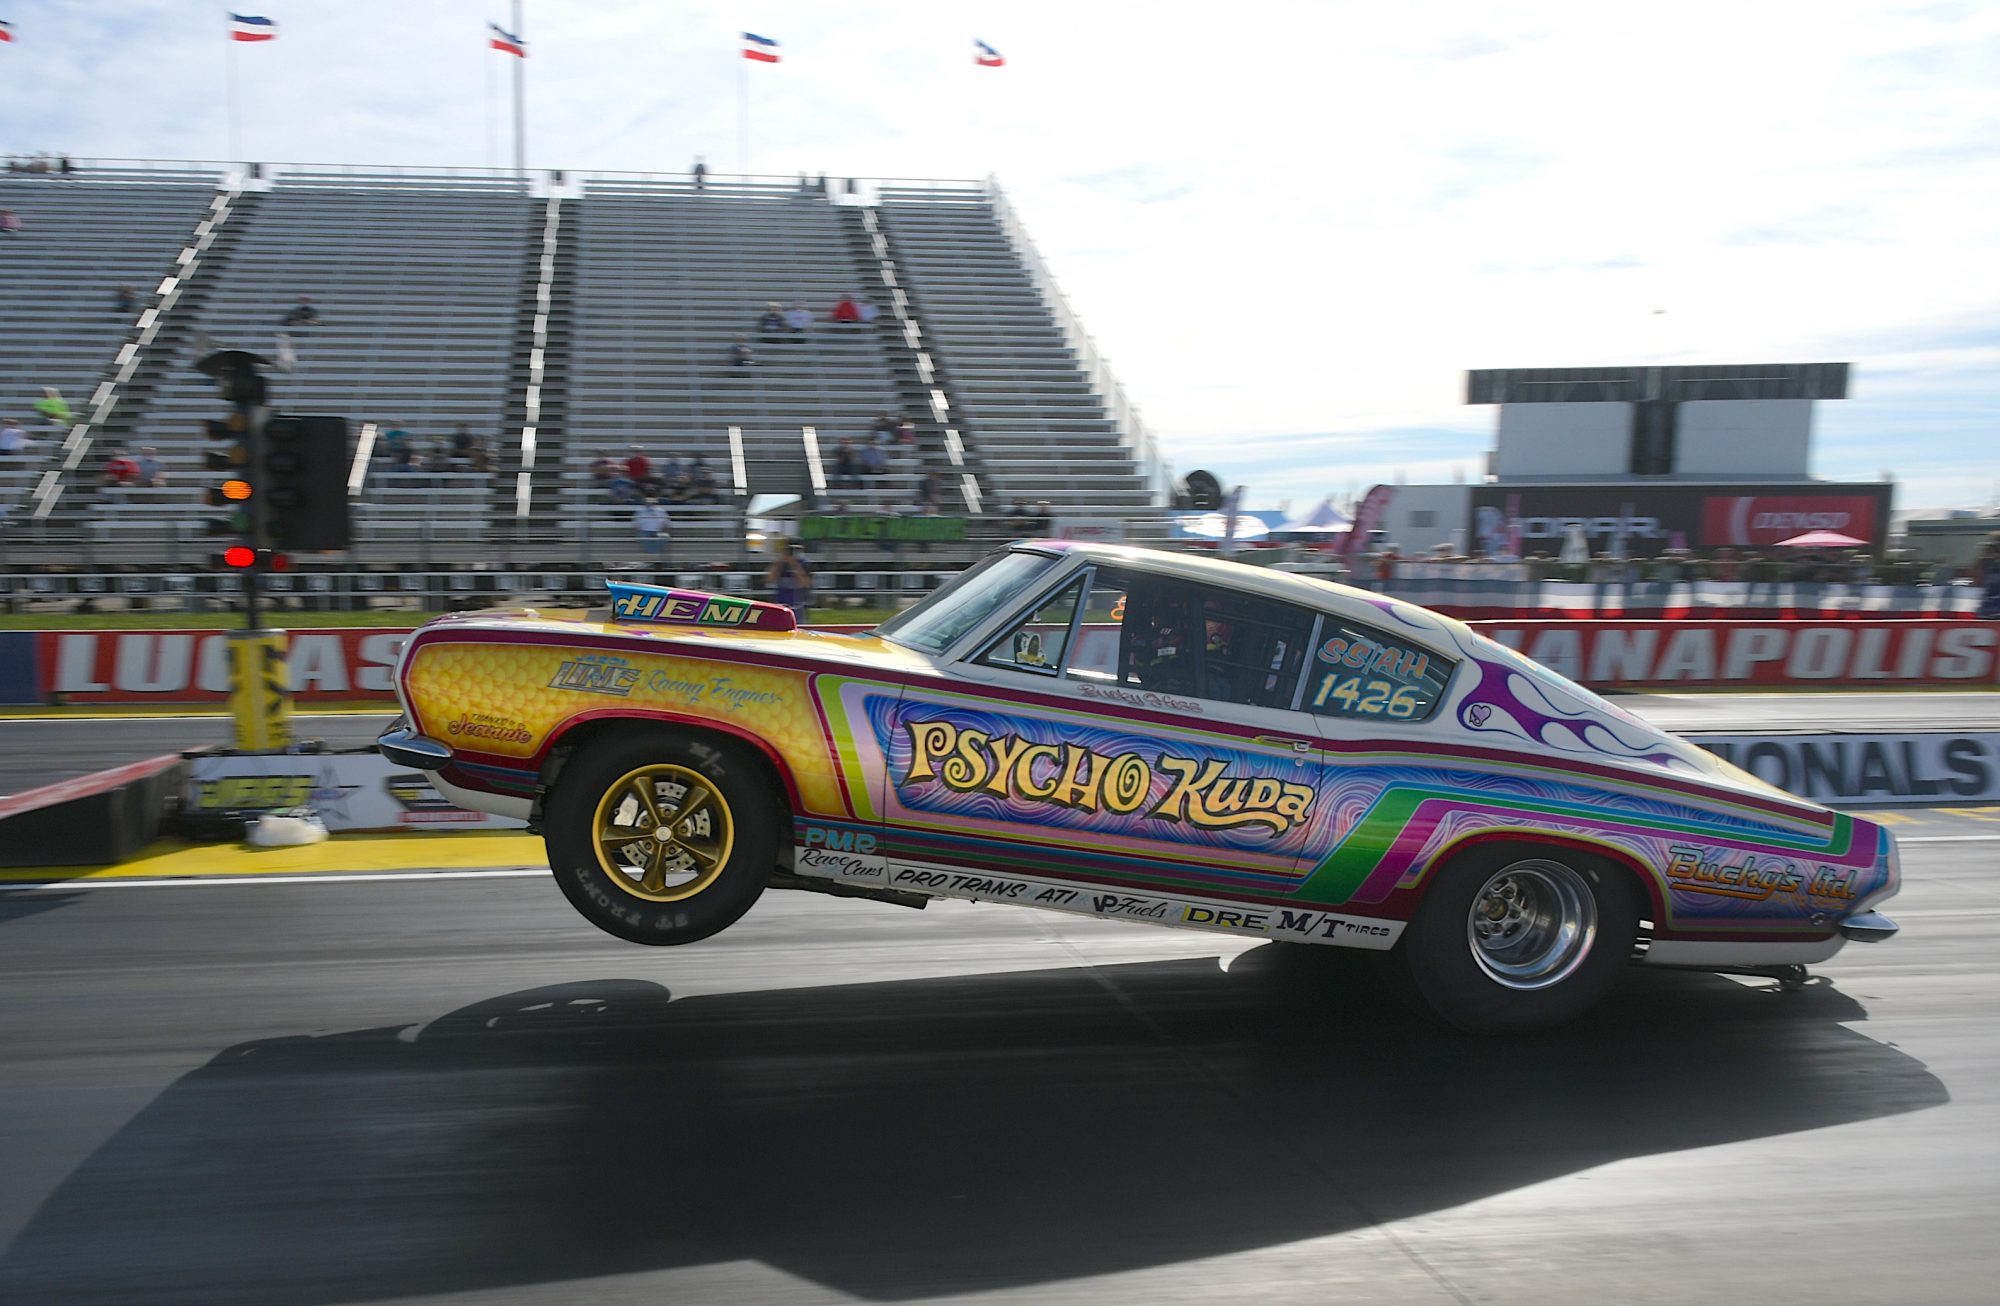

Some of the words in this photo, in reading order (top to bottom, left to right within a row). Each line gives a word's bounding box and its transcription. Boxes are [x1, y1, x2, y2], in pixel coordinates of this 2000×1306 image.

[617, 594, 764, 624] HEMI
[1317, 637, 1430, 680] SS/AH
[549, 660, 641, 696] LINE
[646, 669, 705, 705] Racing
[1312, 672, 1421, 718] 1426
[448, 712, 533, 744] Jeannie
[902, 719, 1152, 816] PSYCHO
[800, 848, 849, 868] Race
[842, 859, 884, 877] Cars
[804, 826, 878, 855] PMR
[1666, 846, 1804, 901] Bucky's
[894, 869, 948, 888] PRO
[947, 875, 1028, 898] TRANS
[1034, 887, 1079, 905] ATI
[1093, 894, 1119, 912] VP
[1109, 897, 1169, 919] Fuels
[1183, 905, 1270, 932] DRE
[1276, 910, 1346, 939] M/T
